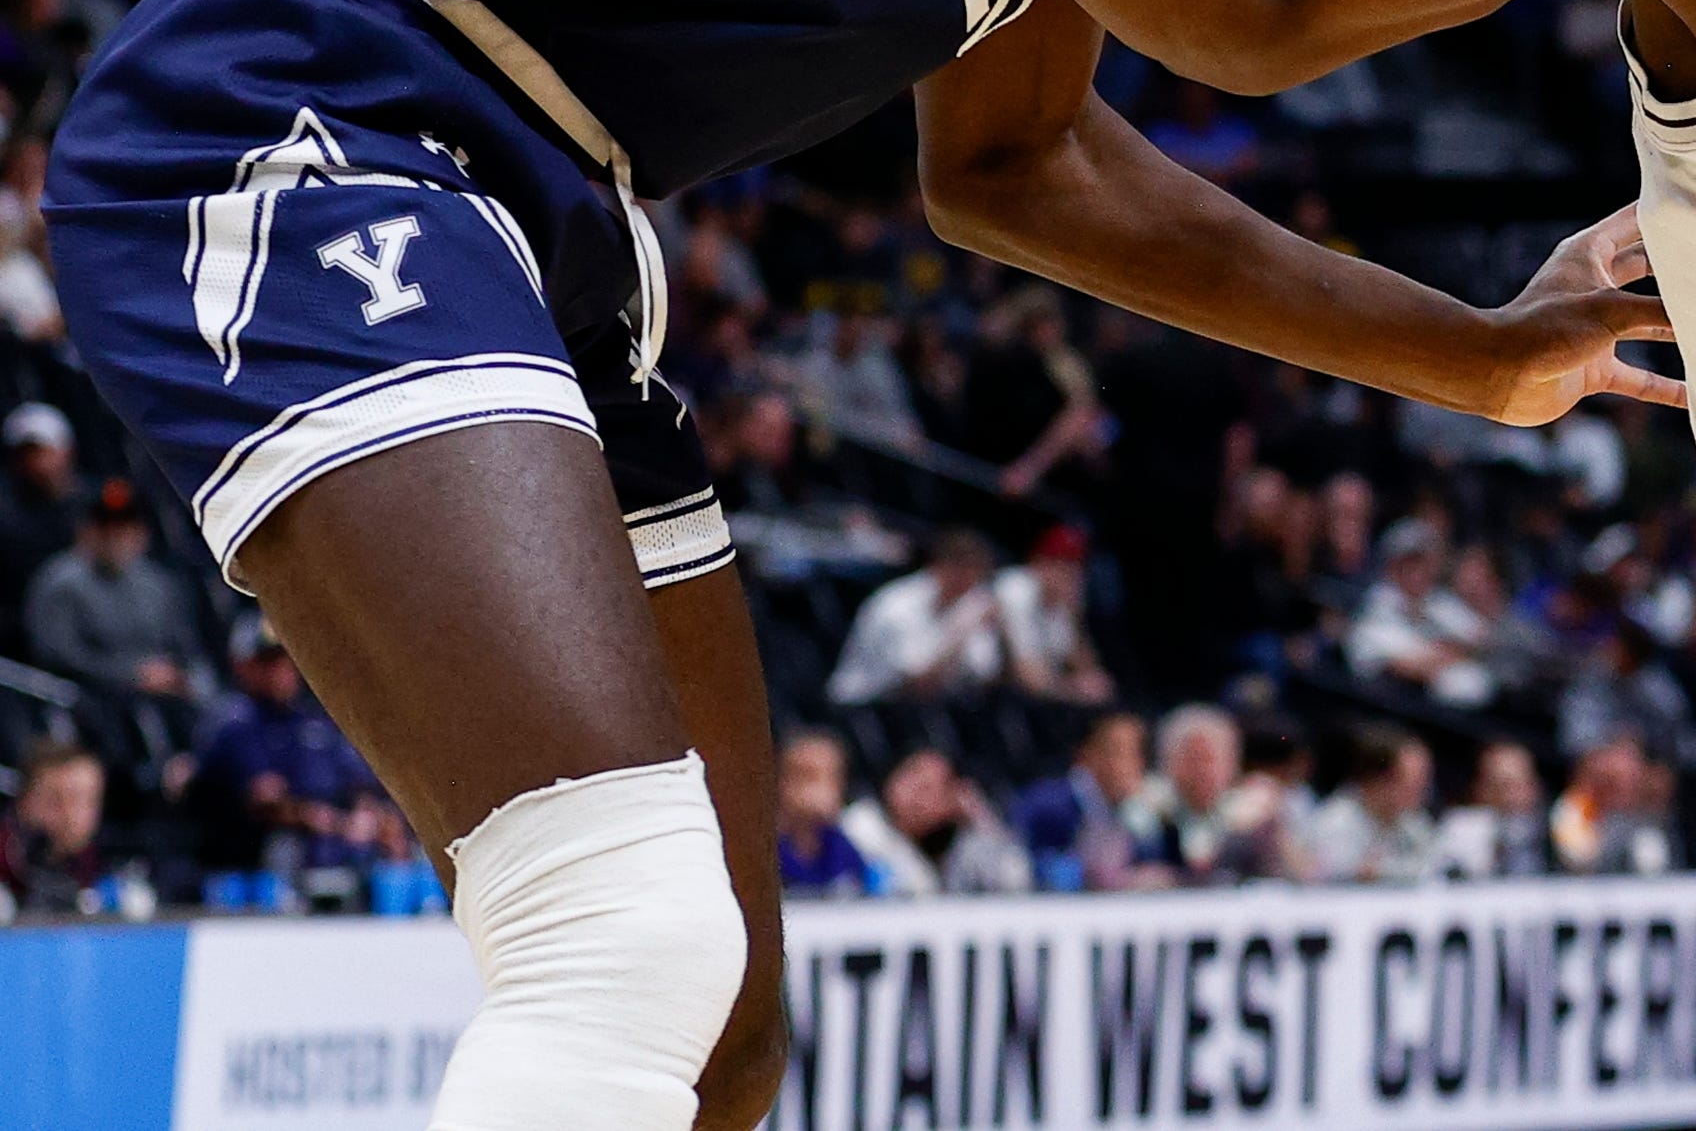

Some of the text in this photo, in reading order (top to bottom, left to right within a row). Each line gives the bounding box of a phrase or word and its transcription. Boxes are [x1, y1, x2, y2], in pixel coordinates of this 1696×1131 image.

[316, 215, 427, 326] Y
[778, 940, 1050, 1131] NTAIN
[1090, 932, 1332, 1123] WEST
